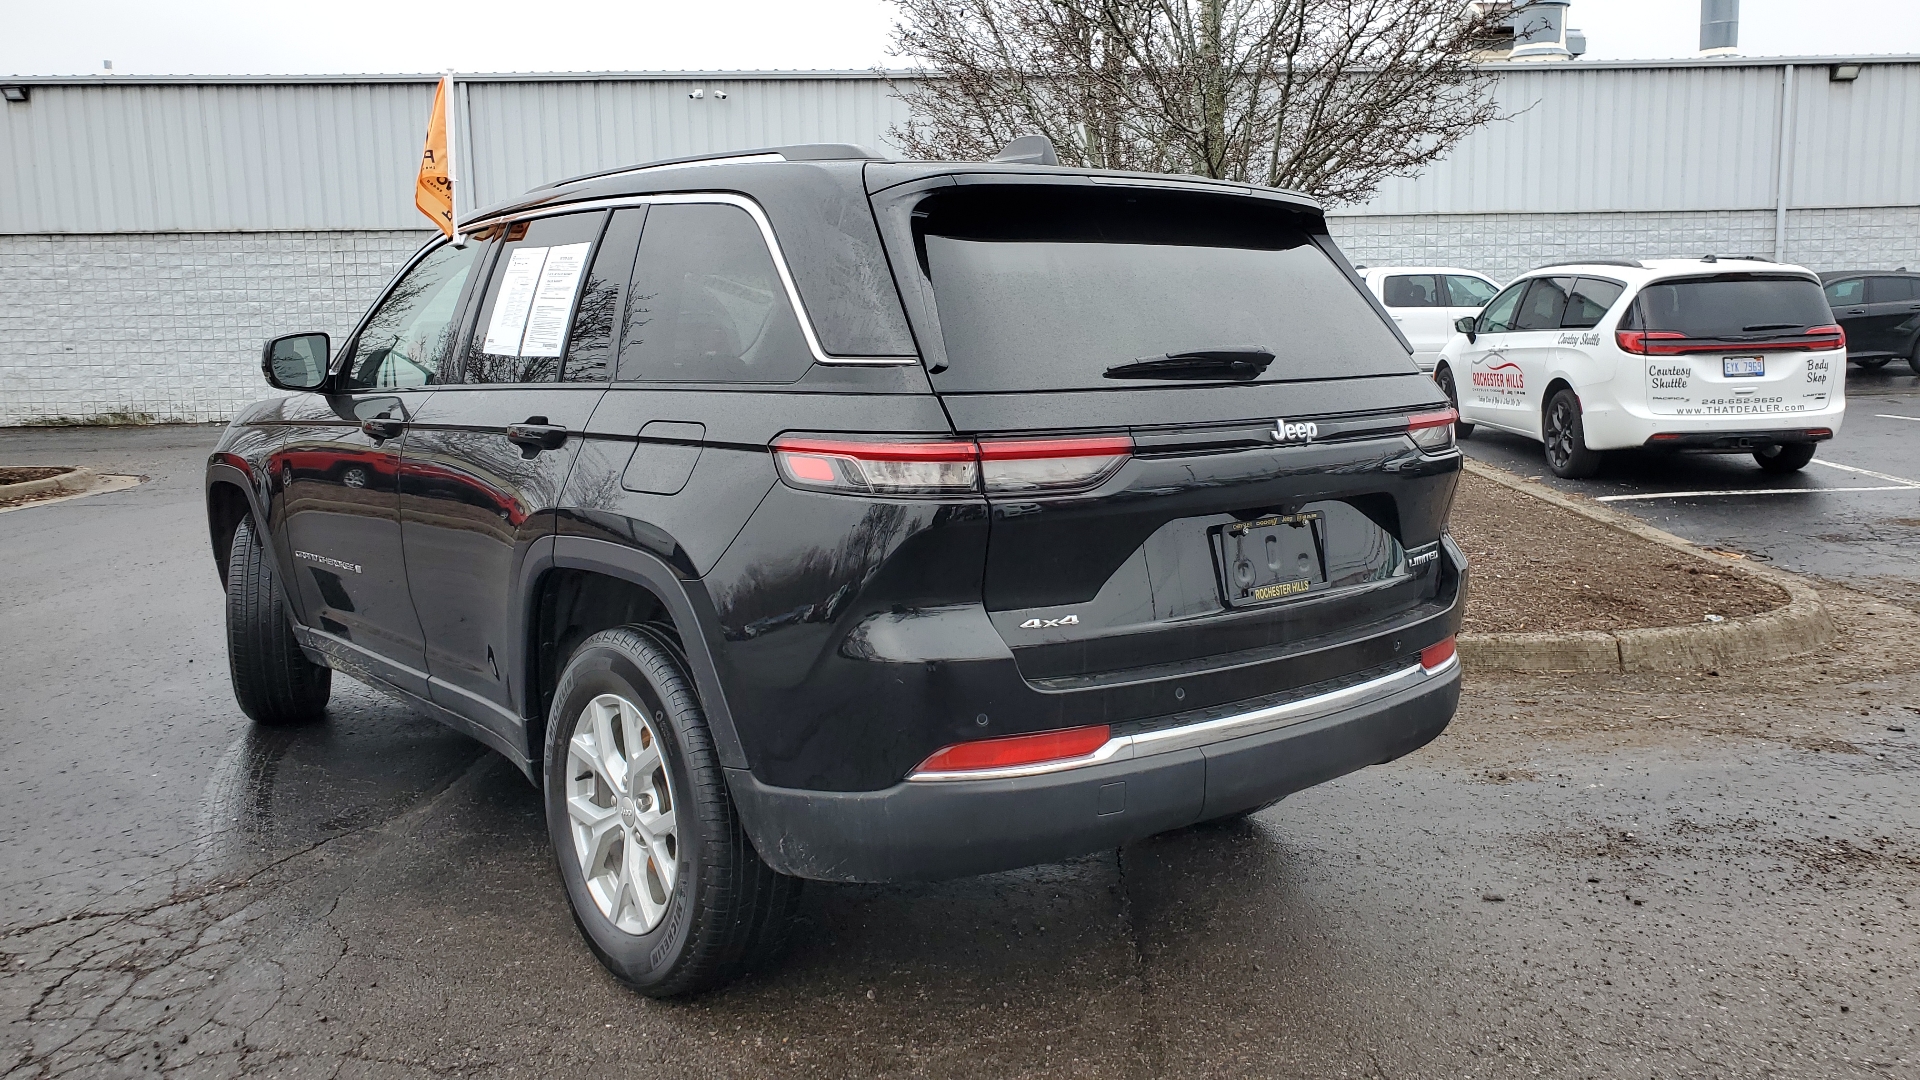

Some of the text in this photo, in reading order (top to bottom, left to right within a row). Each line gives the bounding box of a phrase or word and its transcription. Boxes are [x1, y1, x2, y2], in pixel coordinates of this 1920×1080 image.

[1579, 333, 1601, 346] Shuttle
[1649, 365, 1691, 378] Courtesy
[1726, 361, 1762, 373] EYK 7969
[1806, 359, 1829, 371] Body
[1472, 372, 1524, 389] ROCHESTER HILLS
[1652, 378, 1688, 389] Shuttle
[1806, 372, 1827, 384] Shop
[1701, 396, 1783, 405] 248-652-9650
[1676, 404, 1805, 415] www.THATDEALER.com
[1270, 418, 1318, 443] Jeep
[1408, 550, 1438, 568] LIMITED
[1254, 580, 1309, 600] ROCHESTER HILLS
[650, 899, 684, 967] MICHELIN
